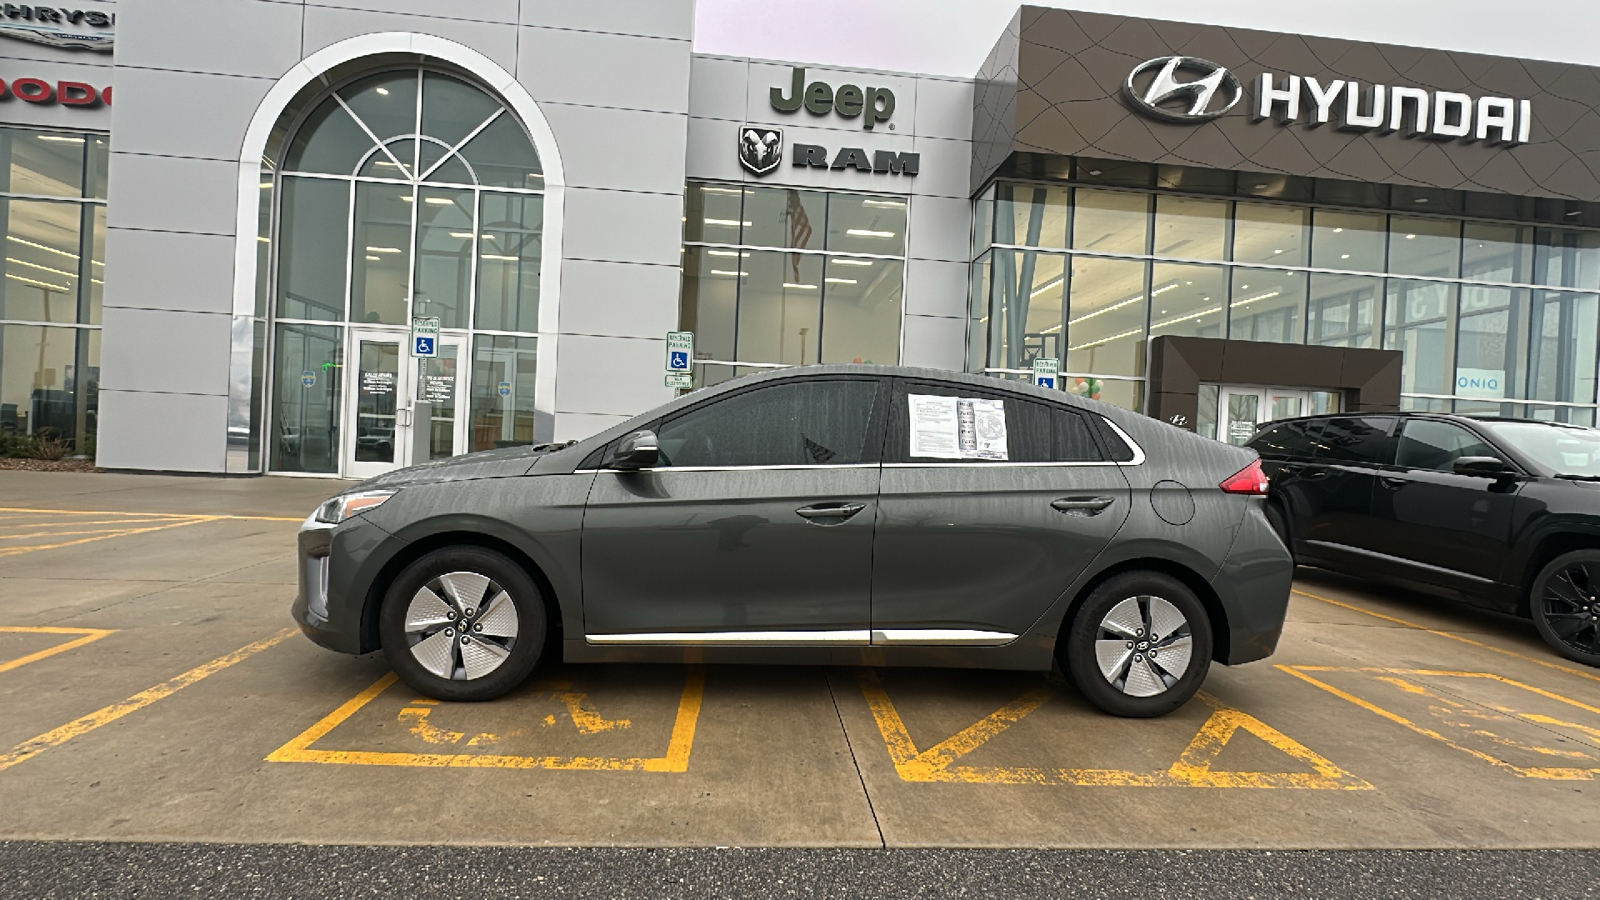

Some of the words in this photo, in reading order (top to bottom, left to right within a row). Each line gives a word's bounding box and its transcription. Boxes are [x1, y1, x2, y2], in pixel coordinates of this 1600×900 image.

[0, 3, 115, 26] HRYS
[0, 77, 113, 106] OD
[769, 67, 896, 129] Jeep
[1254, 72, 1531, 147] HYUNDAI
[792, 143, 920, 176] RAM
